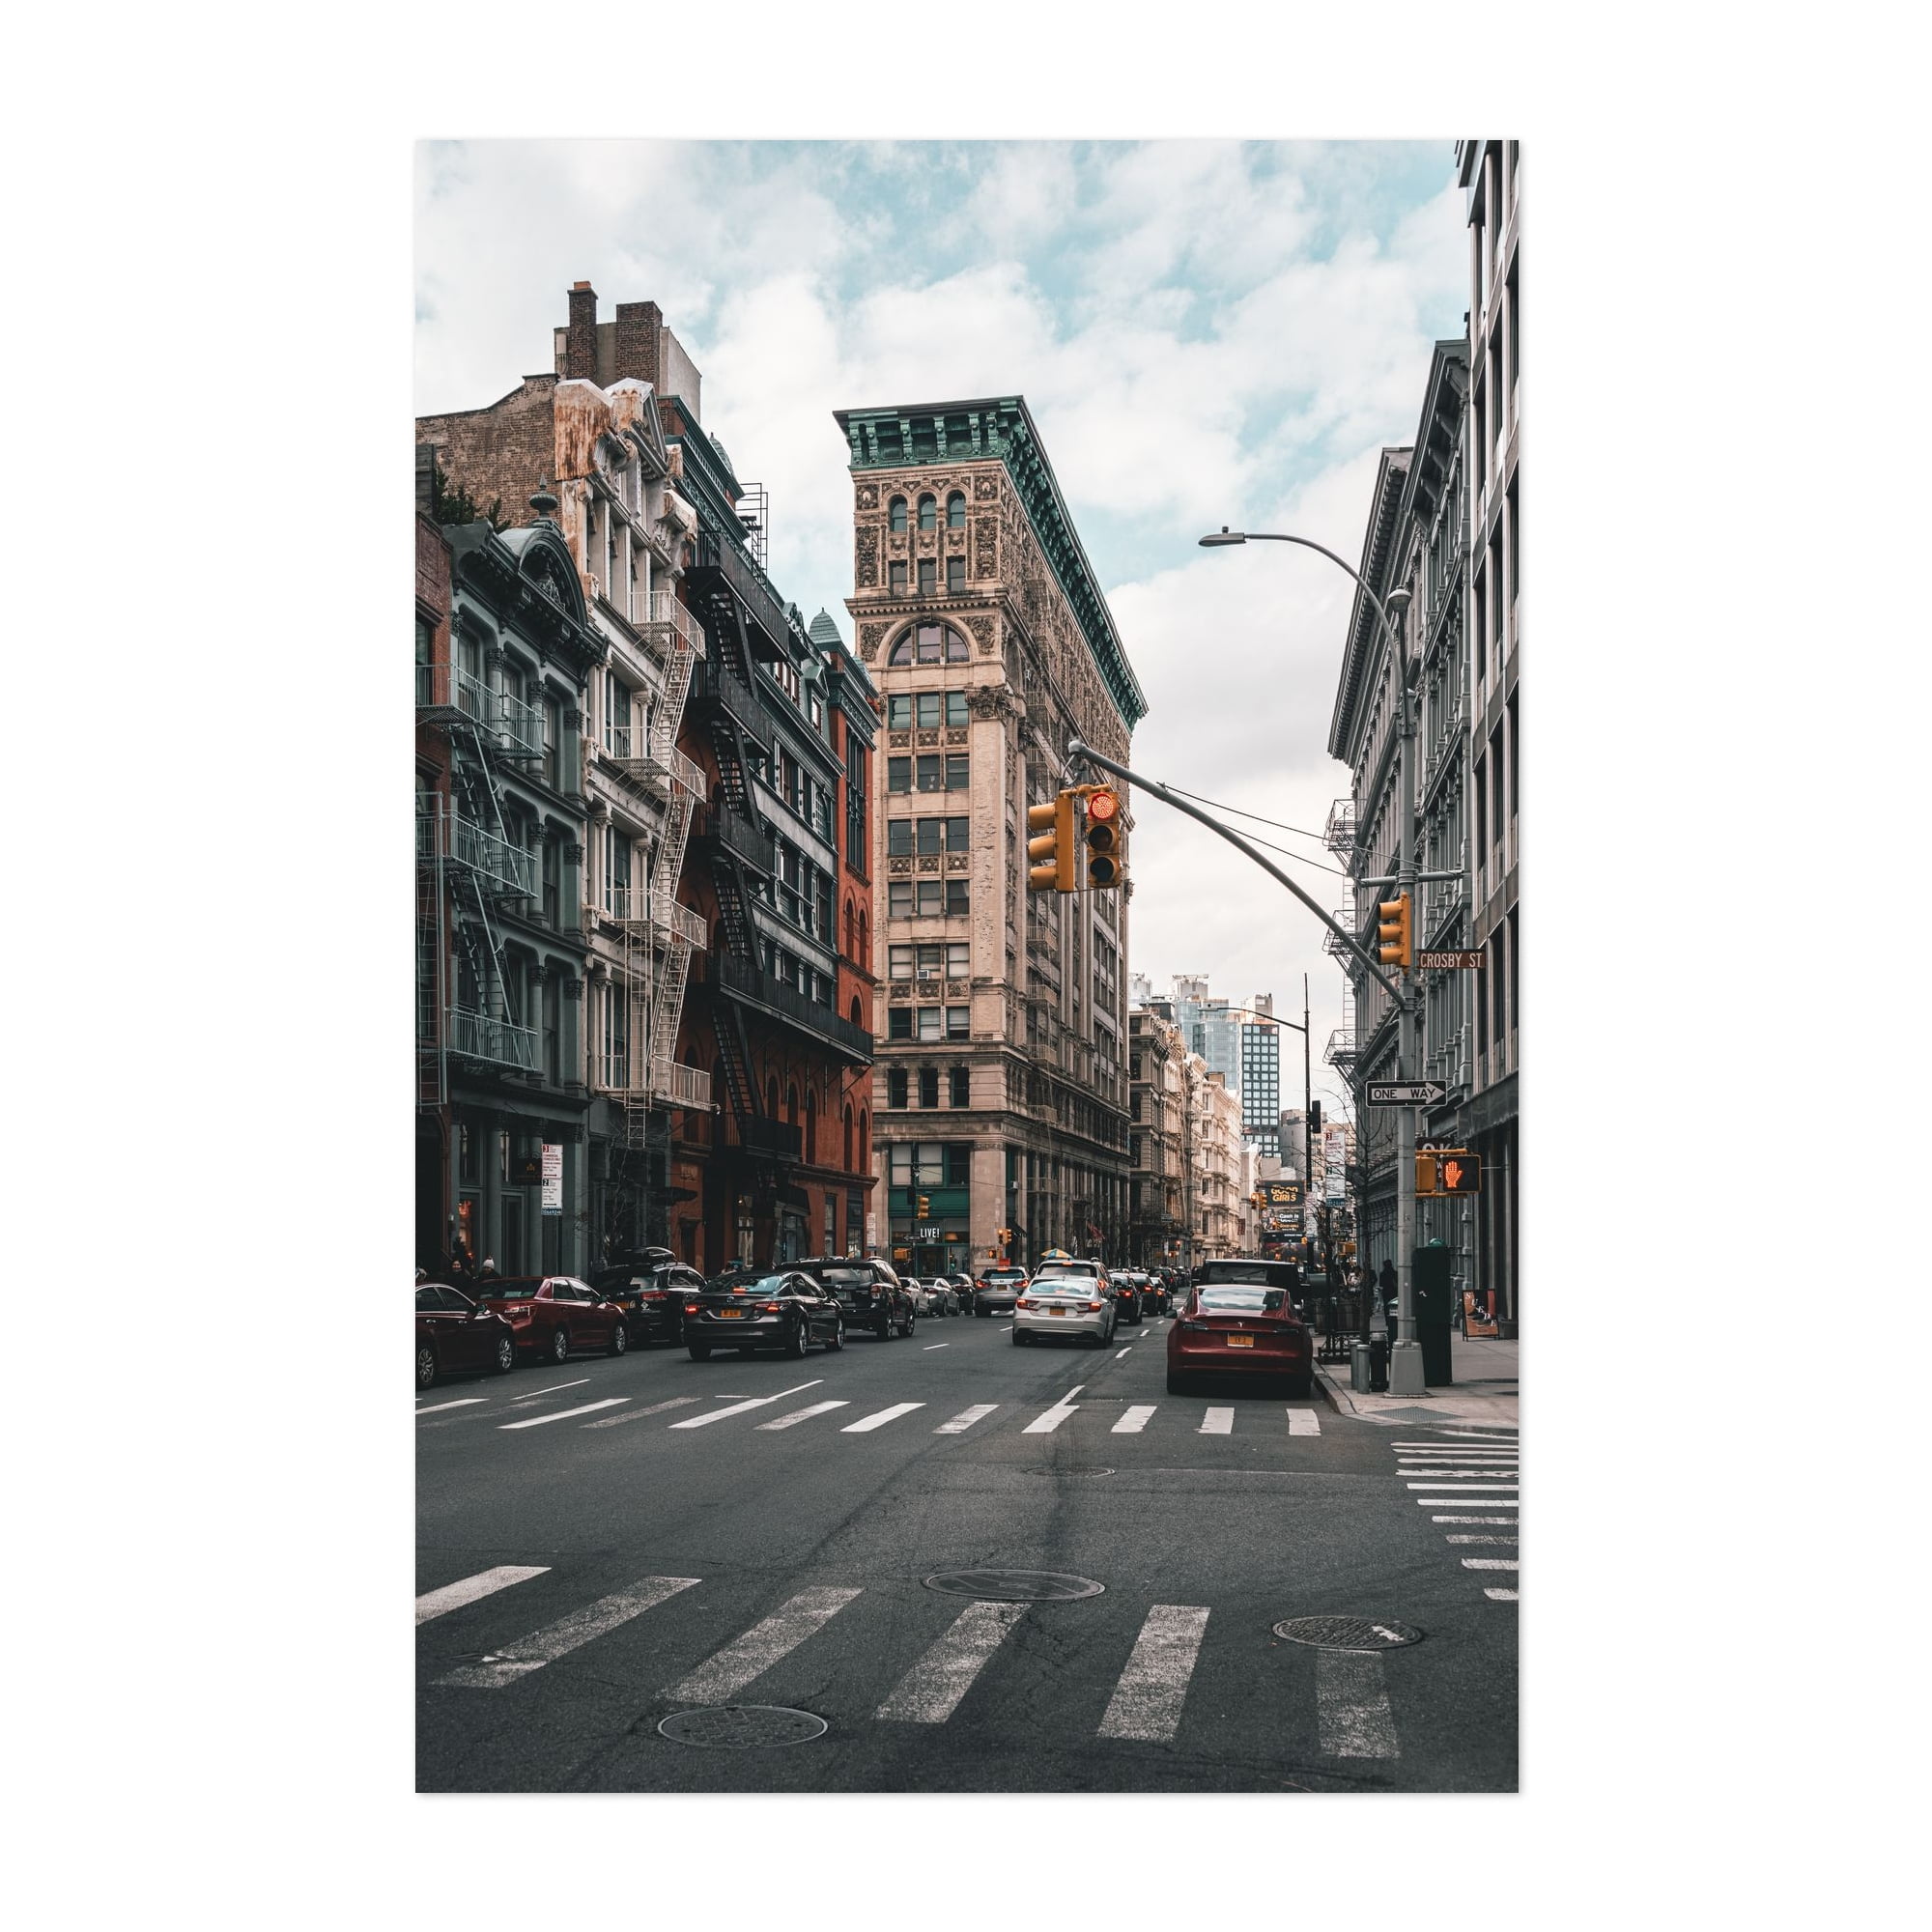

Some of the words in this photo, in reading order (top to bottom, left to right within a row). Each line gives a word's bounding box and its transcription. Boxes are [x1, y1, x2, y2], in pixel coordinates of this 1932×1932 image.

[1420, 952, 1463, 968] CROSBY
[1468, 952, 1482, 968] ST
[1374, 1089, 1397, 1099] ONE
[1410, 1088, 1435, 1098] WAY
[920, 1228, 940, 1238] LIVE!
